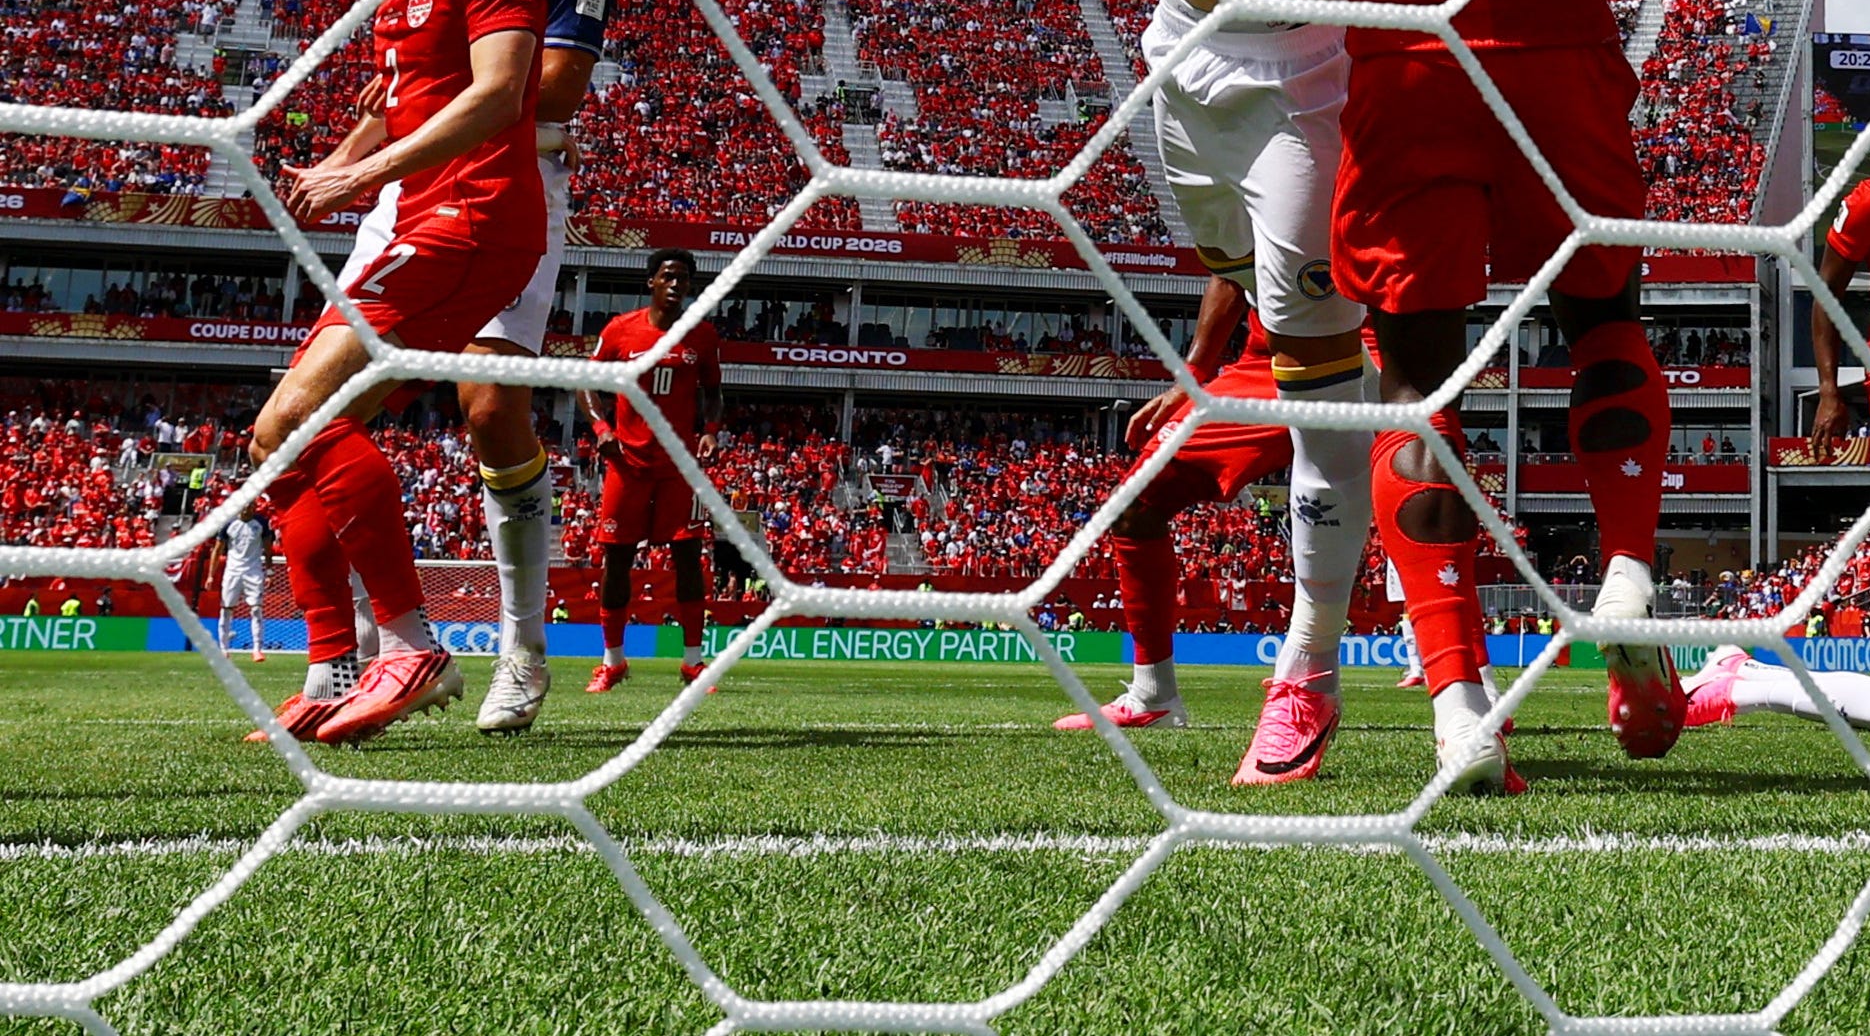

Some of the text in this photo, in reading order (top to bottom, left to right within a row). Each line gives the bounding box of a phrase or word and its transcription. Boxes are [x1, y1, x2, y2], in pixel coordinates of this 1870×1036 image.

[385, 47, 399, 108] 2
[709, 231, 903, 254] FIFA RLD CUP 2026
[360, 243, 417, 296] 2
[1104, 251, 1177, 269] #FIFAWorldCup
[190, 322, 251, 339] COUPE
[252, 325, 278, 340] DU
[771, 346, 907, 365] TORONTO
[652, 367, 673, 395] 10
[812, 629, 935, 661] ENERGY
